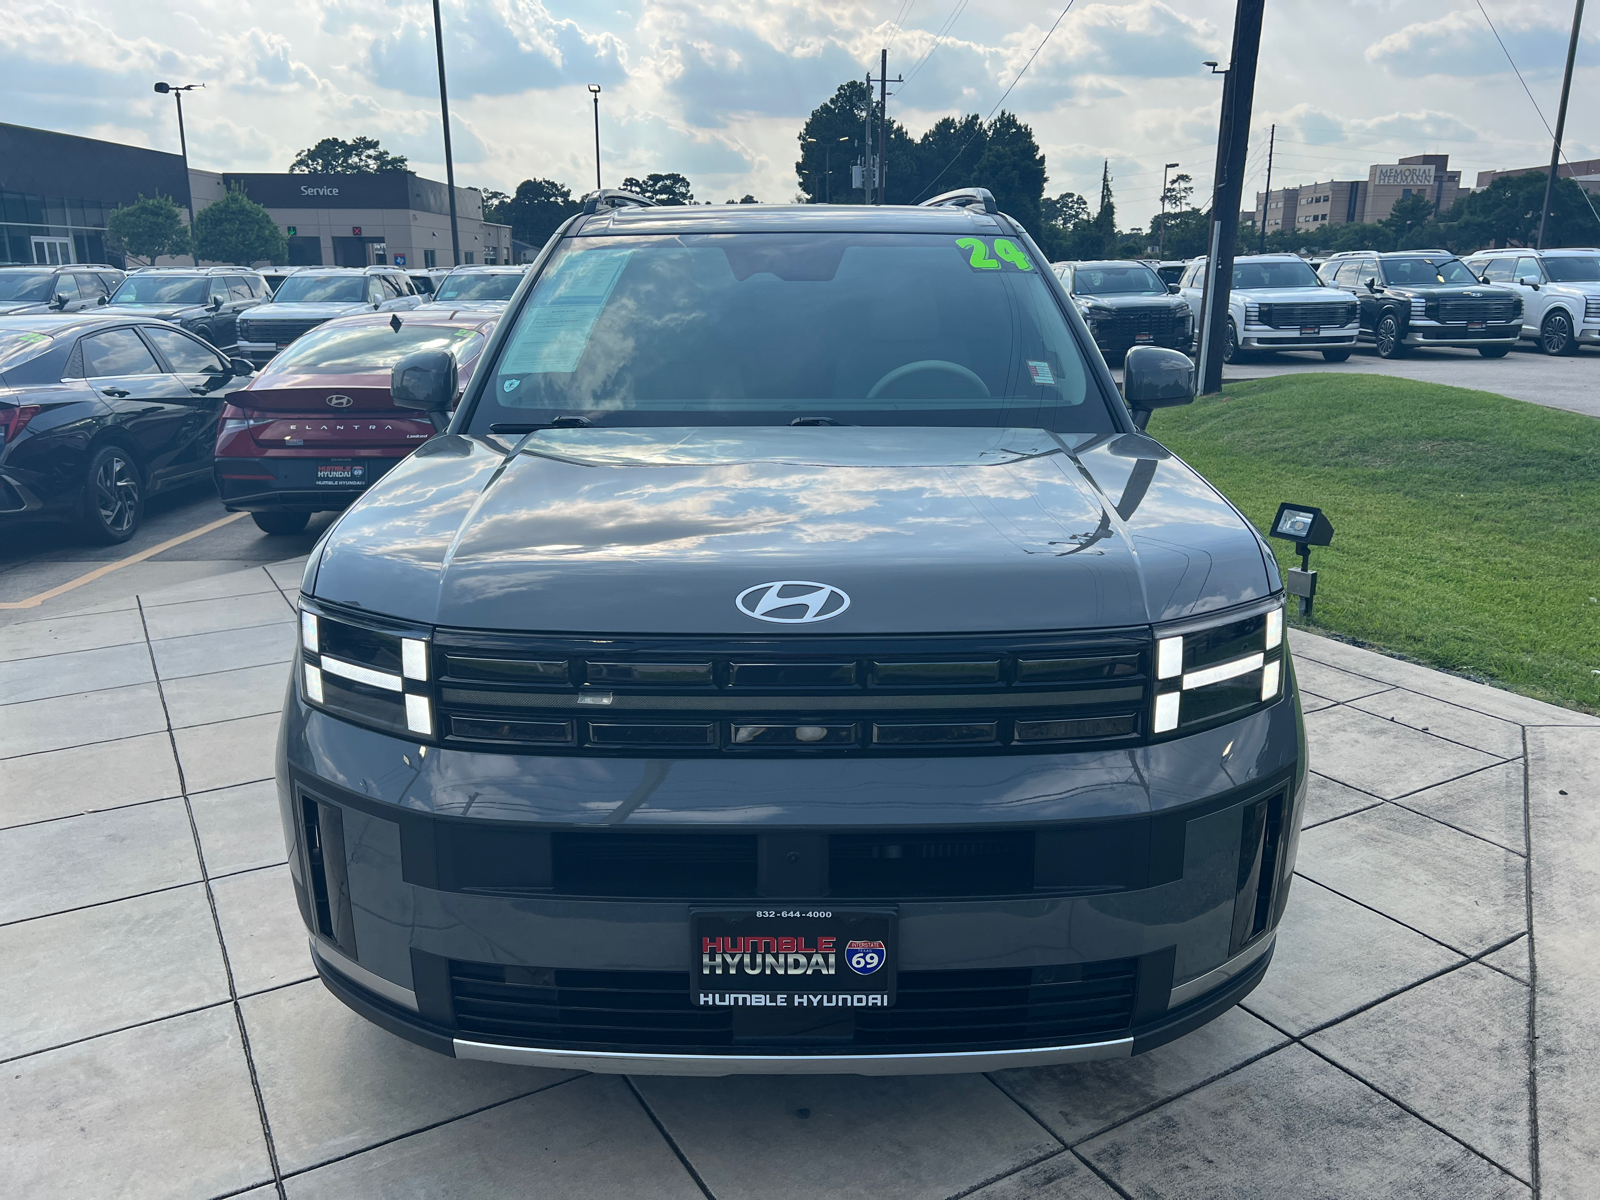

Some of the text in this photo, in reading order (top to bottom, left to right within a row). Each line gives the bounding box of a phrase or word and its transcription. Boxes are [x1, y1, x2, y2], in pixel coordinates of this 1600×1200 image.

[1379, 168, 1432, 177] MEMORIAL
[1378, 175, 1431, 184] HERMANN
[301, 185, 339, 196] Service
[955, 237, 1034, 272] 24
[756, 910, 832, 918] 832-644-4000
[702, 936, 836, 953] HUMBLE
[702, 953, 836, 975] HYUNDAI
[851, 952, 879, 969] 69
[699, 993, 788, 1006] HUMBLE
[794, 994, 888, 1007] HYUNDAI
